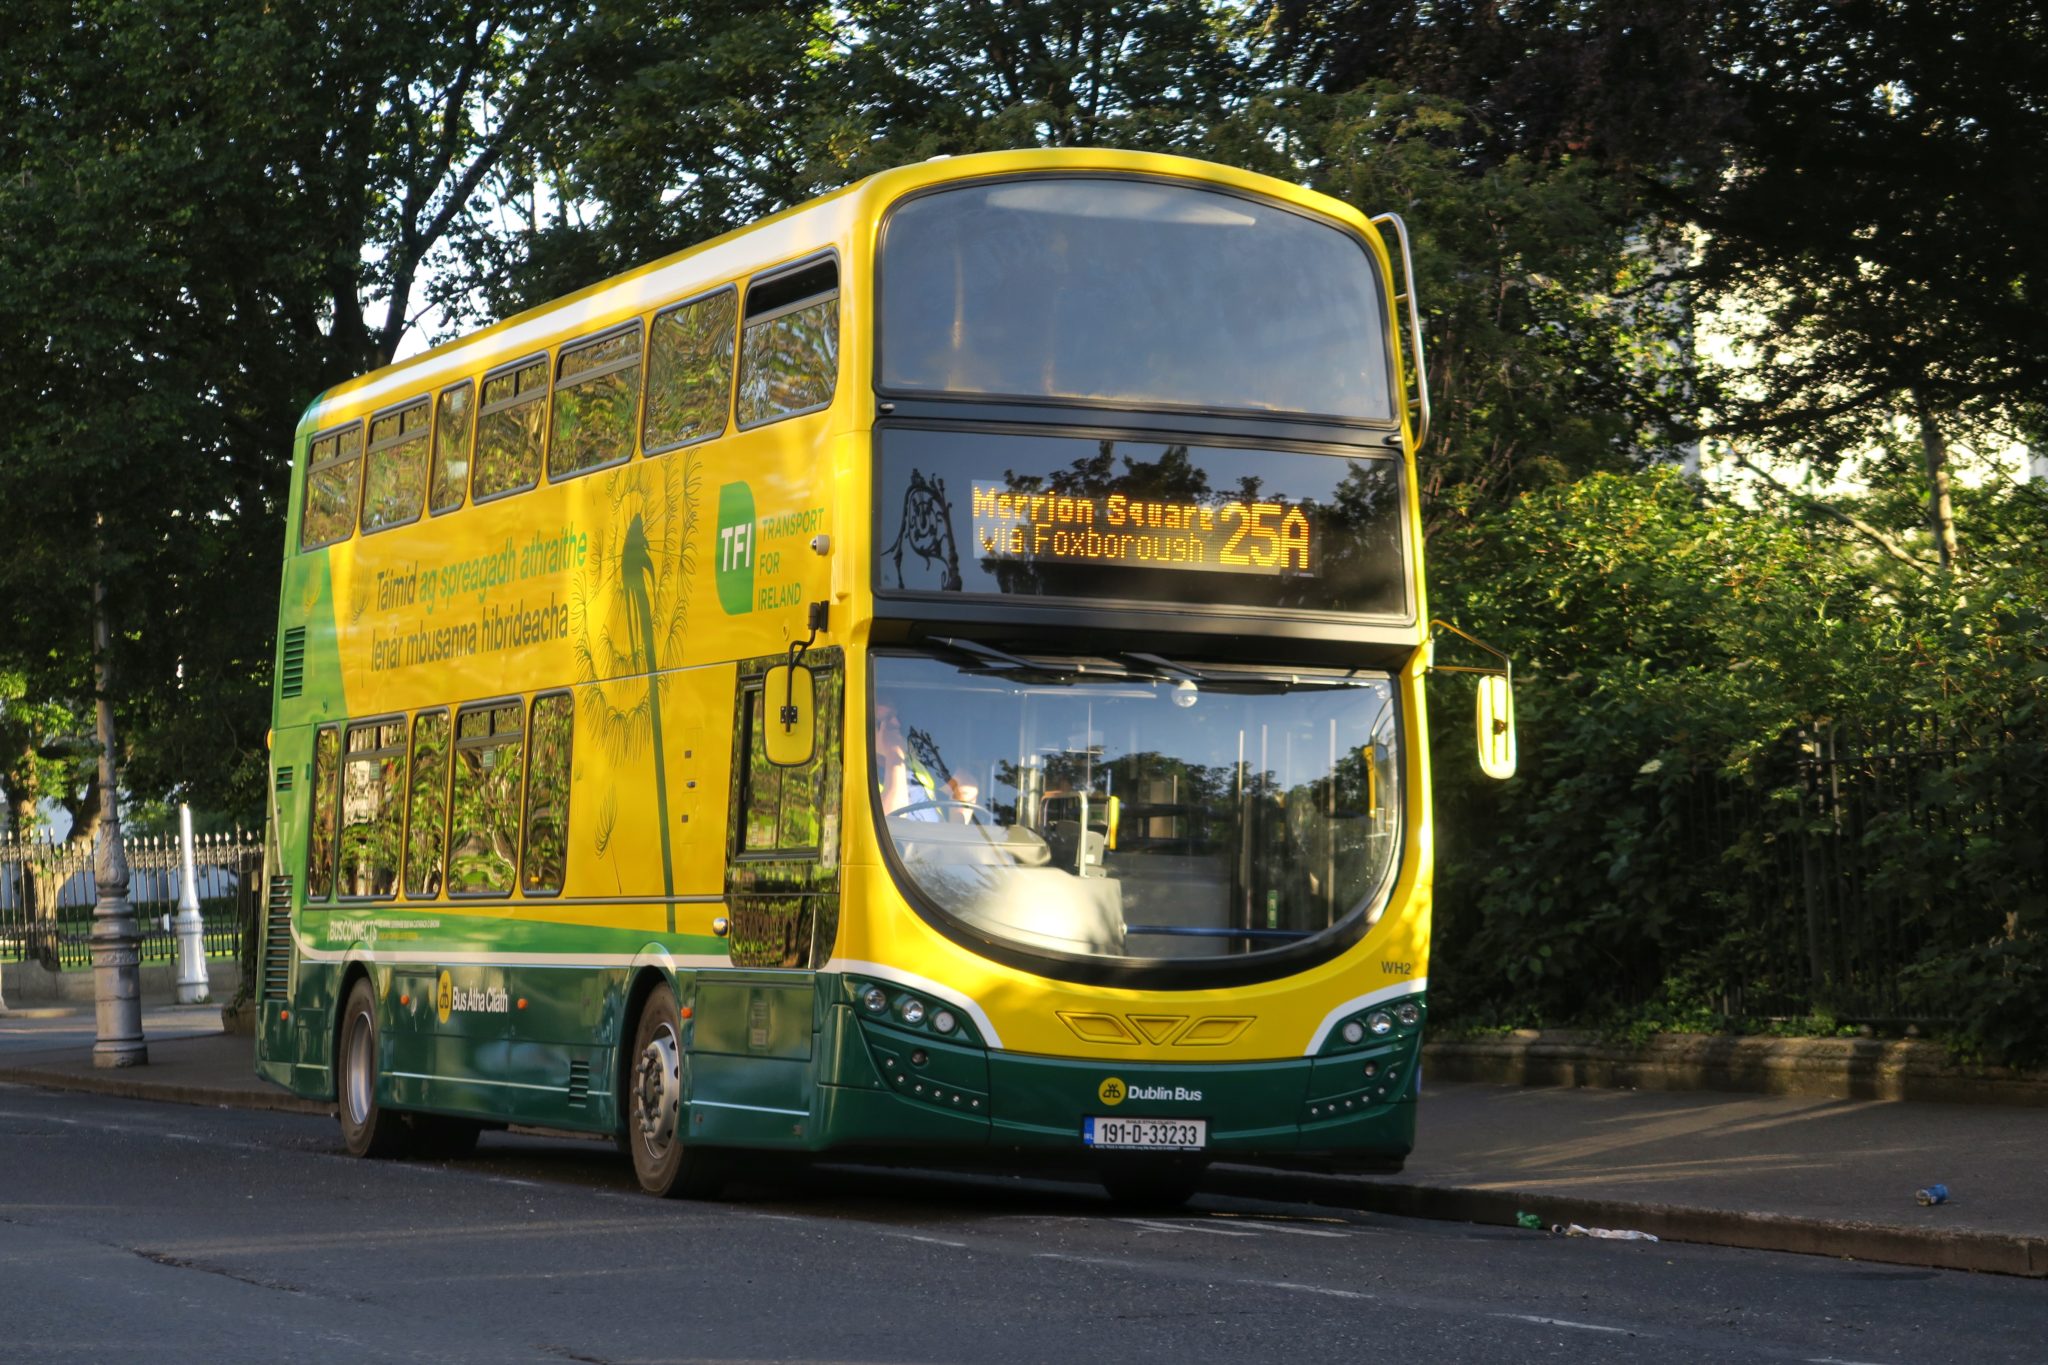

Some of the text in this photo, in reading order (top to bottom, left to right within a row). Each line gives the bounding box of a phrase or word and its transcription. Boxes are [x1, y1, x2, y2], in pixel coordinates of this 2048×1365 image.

[762, 508, 824, 542] TRANSPORT
[973, 486, 1214, 531] Merrion Square
[721, 523, 752, 572] TFI
[978, 521, 1204, 563] via Foxborough
[1219, 502, 1310, 569] 25A
[376, 521, 588, 615] Táimid ag spreagadh athraithe
[760, 552, 781, 576] FOR
[758, 582, 801, 611] IRELAND
[406, 620, 477, 666] mbusanna
[481, 592, 568, 653] hibrideacha
[1381, 961, 1411, 975] WH2
[453, 980, 508, 1013] Bus Átha Cliath
[1128, 1085, 1202, 1101] Dublin Bus
[1102, 1123, 1197, 1145] 191-D-33233
